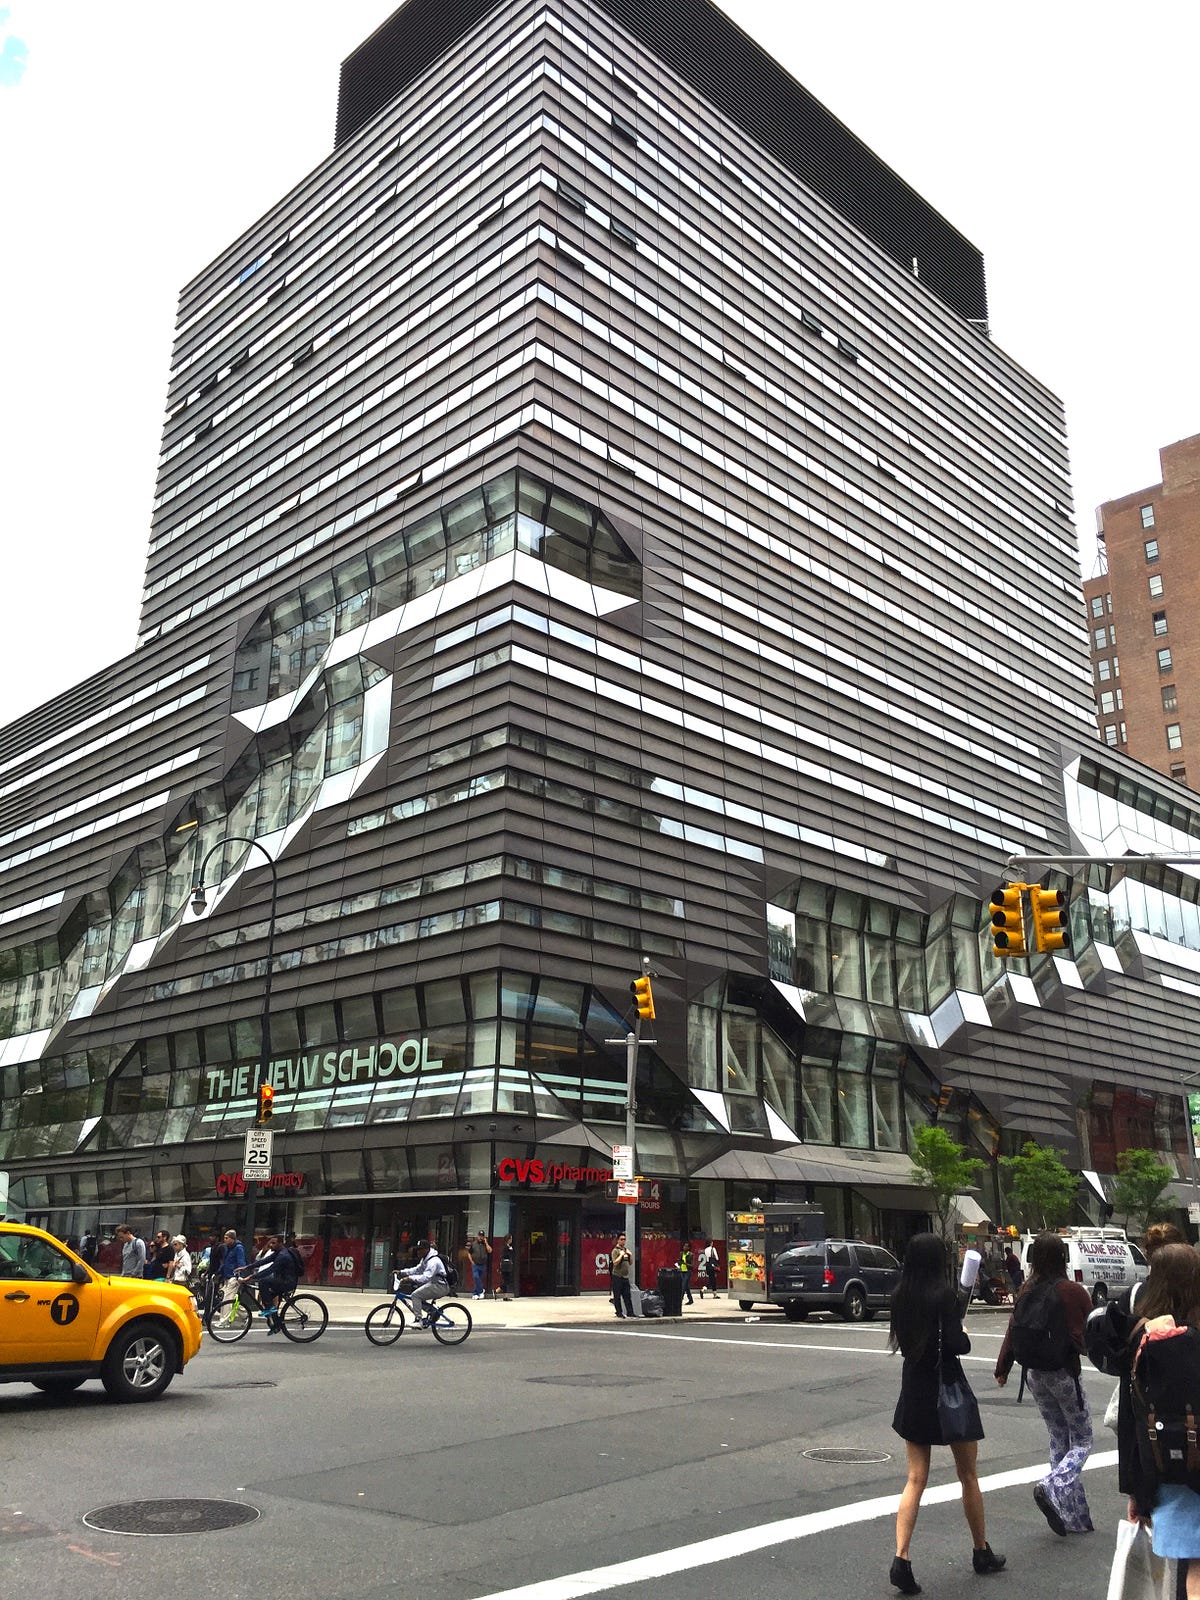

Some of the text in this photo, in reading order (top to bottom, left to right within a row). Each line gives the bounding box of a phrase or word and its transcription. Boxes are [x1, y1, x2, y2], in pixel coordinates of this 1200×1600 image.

[207, 1065, 249, 1099] THE
[322, 1037, 443, 1083] SCHOOL
[248, 1150, 268, 1164] 25
[334, 1256, 354, 1271] CVS
[57, 1299, 74, 1322] T
